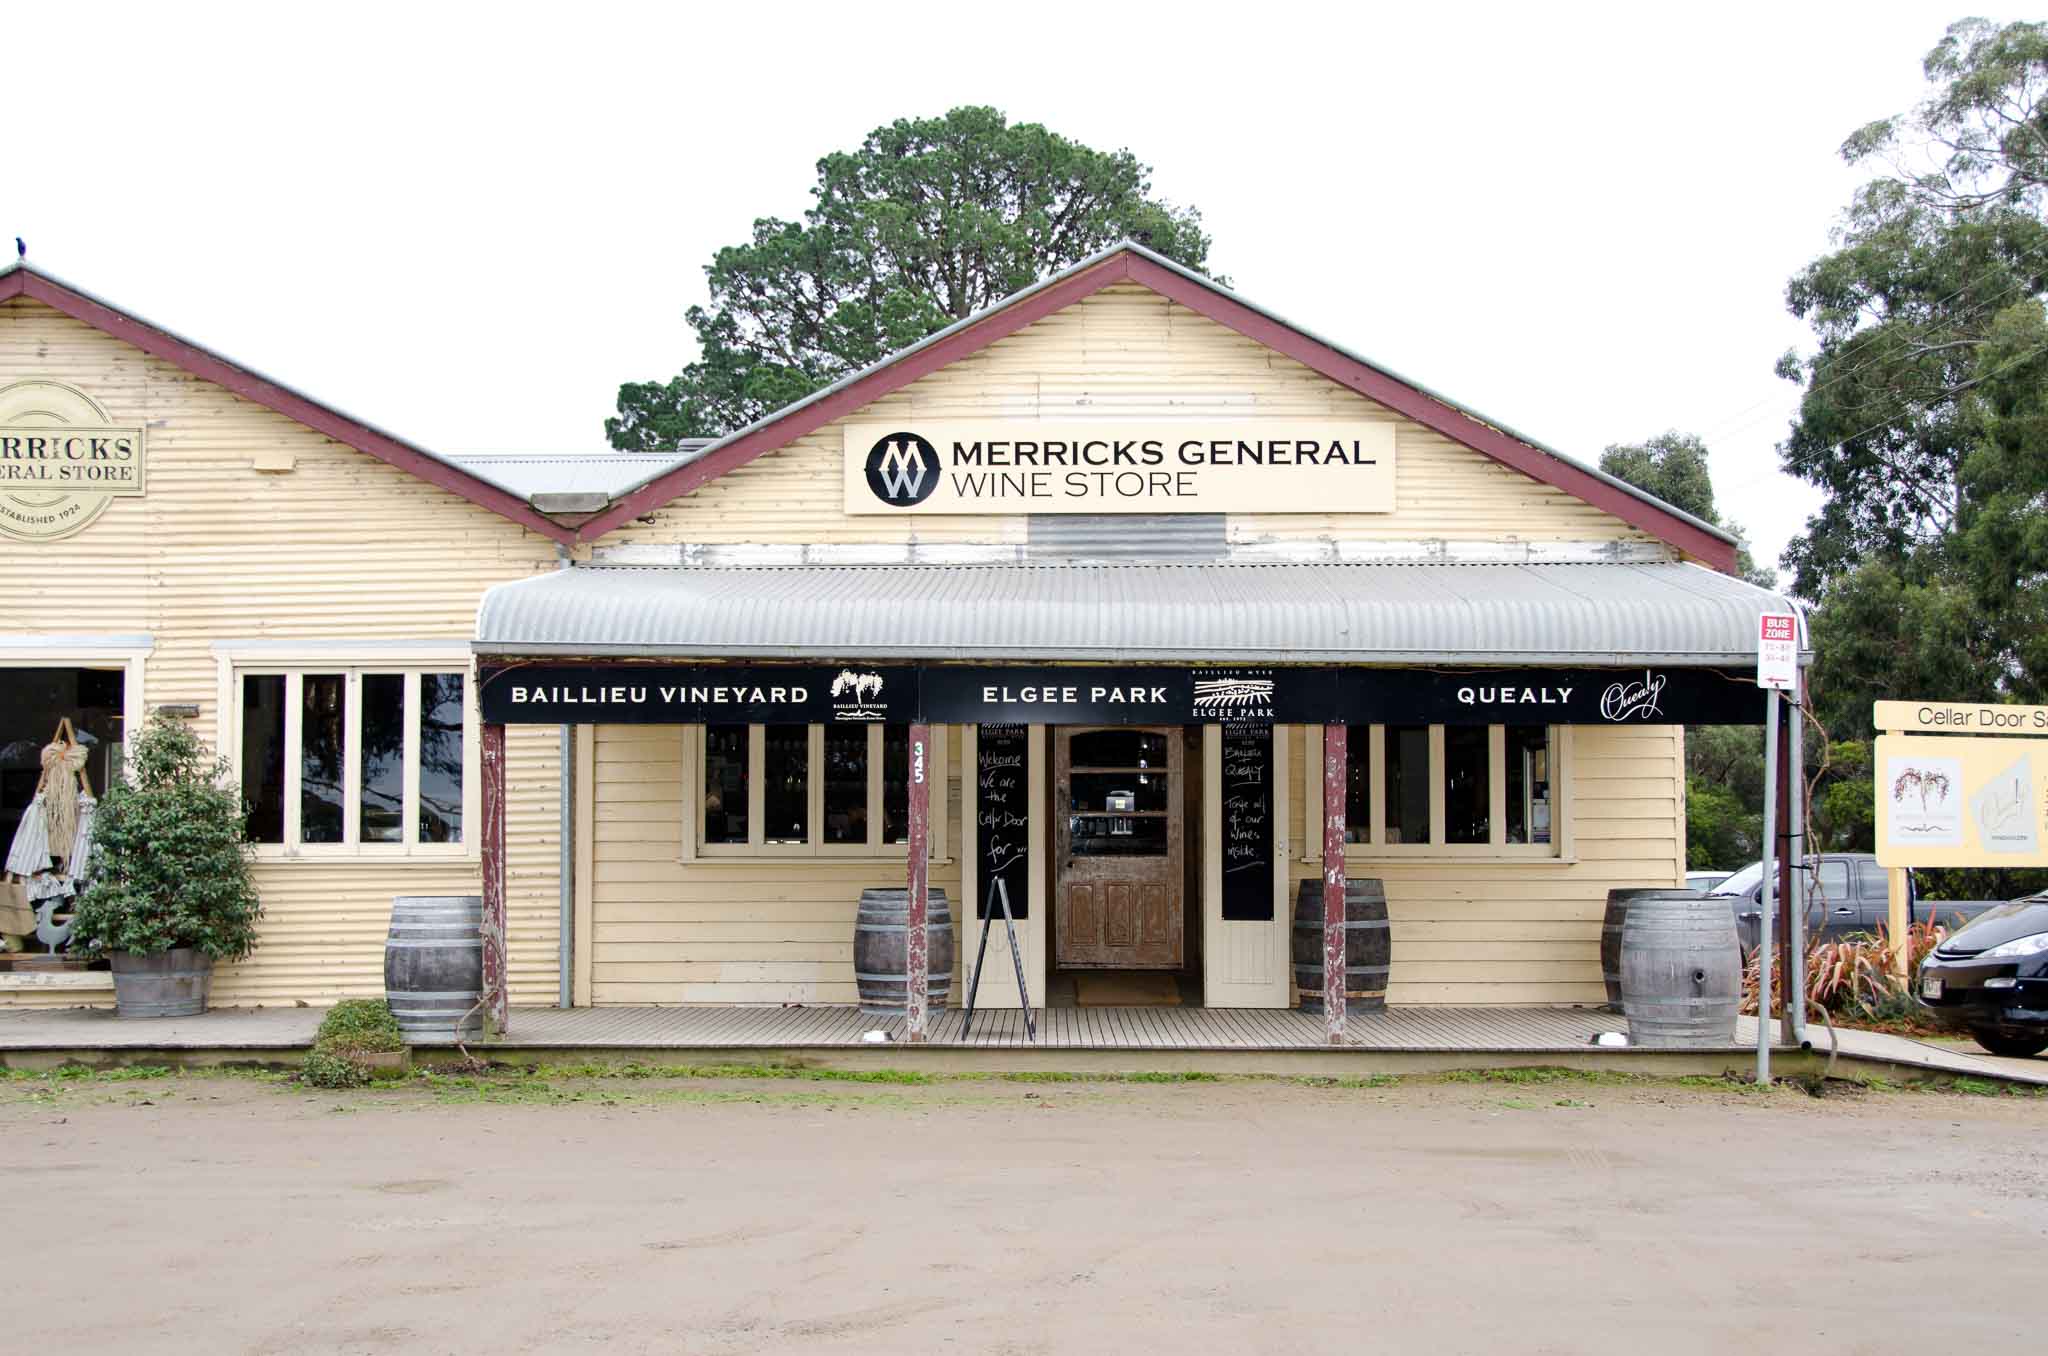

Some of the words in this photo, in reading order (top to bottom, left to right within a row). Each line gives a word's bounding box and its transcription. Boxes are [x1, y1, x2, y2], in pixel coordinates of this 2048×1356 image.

[952, 440, 1164, 466] MERRICKS
[1178, 440, 1377, 465] GENERAL
[59, 465, 133, 481] STORE
[952, 472, 1052, 497] WINE
[1064, 471, 1198, 498] STORE
[1766, 618, 1789, 629] BUS
[1765, 629, 1791, 639] ZONE
[511, 687, 647, 703] BAILLIEU
[660, 687, 808, 703] VINEYARD
[983, 687, 1078, 703] ELGEE
[1091, 687, 1167, 703] PARK
[1457, 687, 1574, 705] QUEALY
[1600, 669, 1667, 721] Quealy
[1192, 708, 1233, 717] ELGEE
[1240, 708, 1275, 717] PARK
[1918, 707, 1972, 726] Cellar
[1979, 709, 2026, 727] Door
[2033, 710, 2048, 728] S
[914, 741, 924, 784] 345
[979, 751, 1021, 768] Welcome
[980, 770, 996, 788] We
[999, 778, 1016, 788] are
[985, 790, 1007, 803] the
[1003, 810, 1028, 827] Door
[1245, 815, 1264, 824] our
[986, 834, 1012, 864] for
